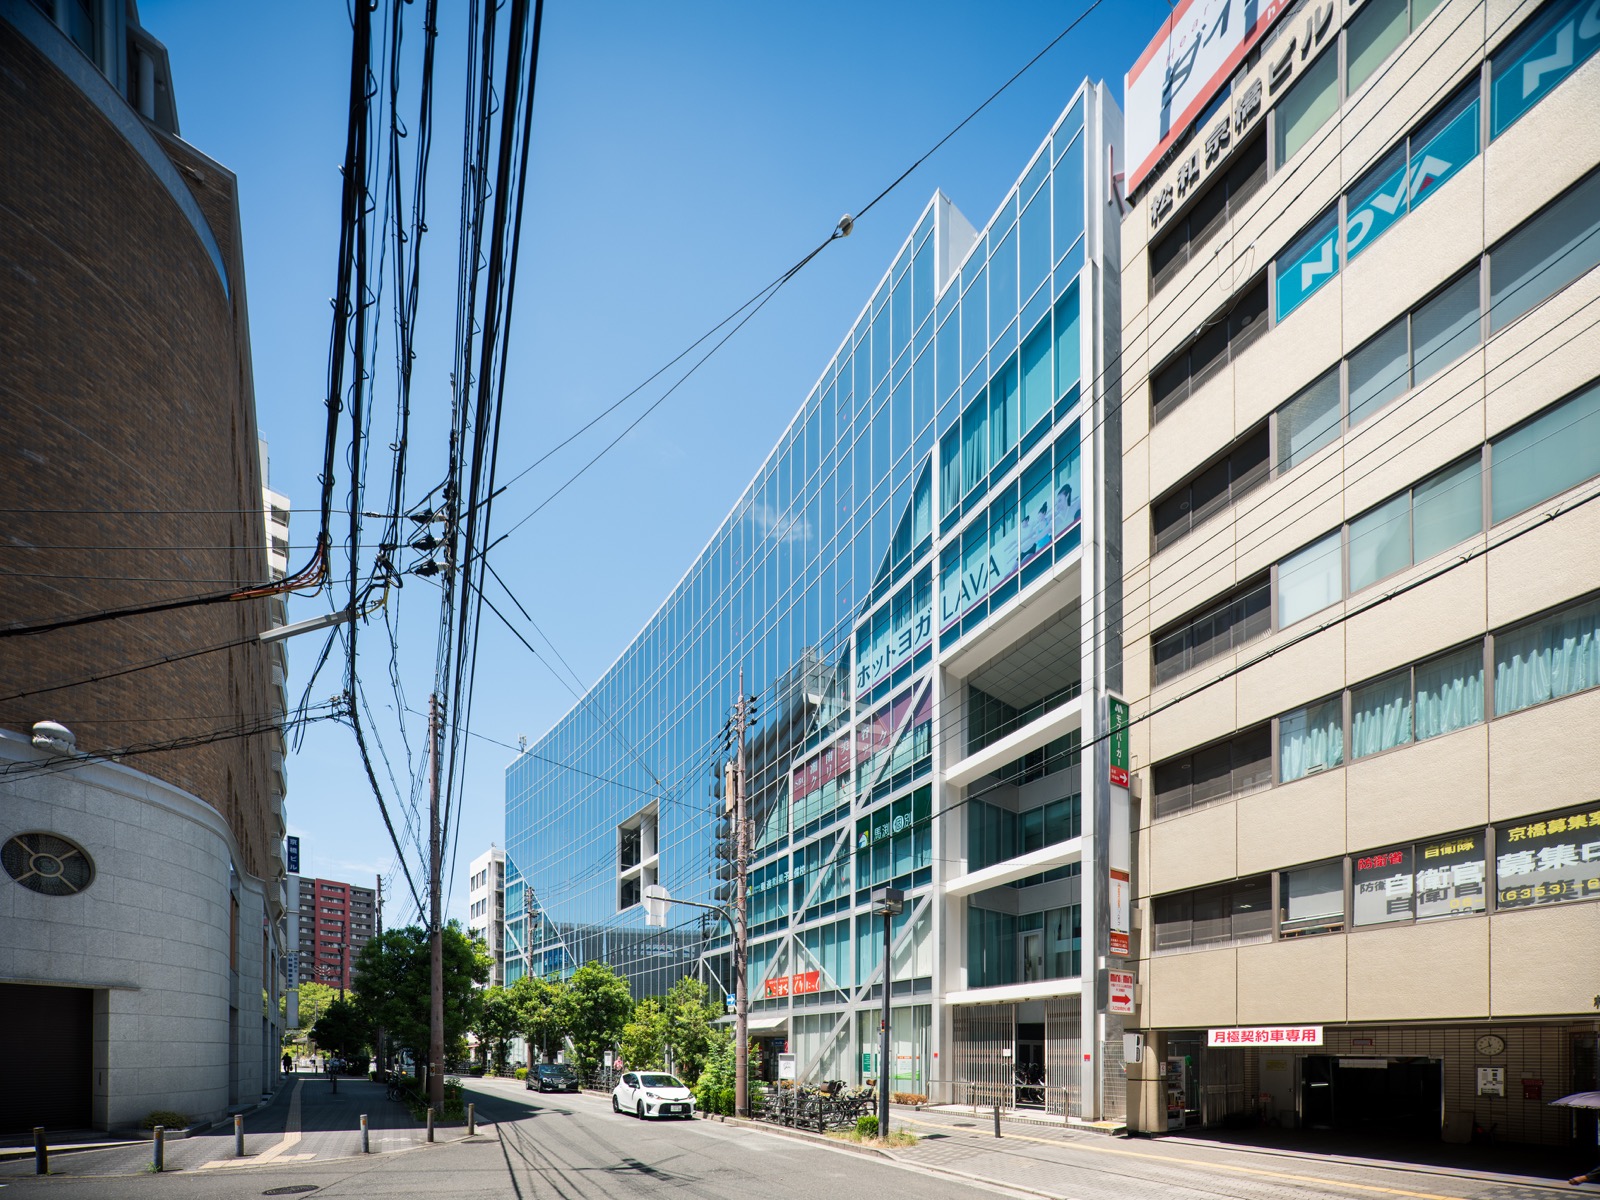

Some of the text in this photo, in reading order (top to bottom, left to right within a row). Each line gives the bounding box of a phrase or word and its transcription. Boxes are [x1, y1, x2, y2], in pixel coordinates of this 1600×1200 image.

[1151, 0, 1357, 226] 松和京橋ビル
[1301, 155, 1453, 292] NOVA
[857, 554, 1000, 688] ホットヨガ LAVA
[1358, 851, 1403, 871] 防衛省
[1425, 838, 1475, 859] 自衛隊
[1214, 1029, 1316, 1043] 月極契約車専用
